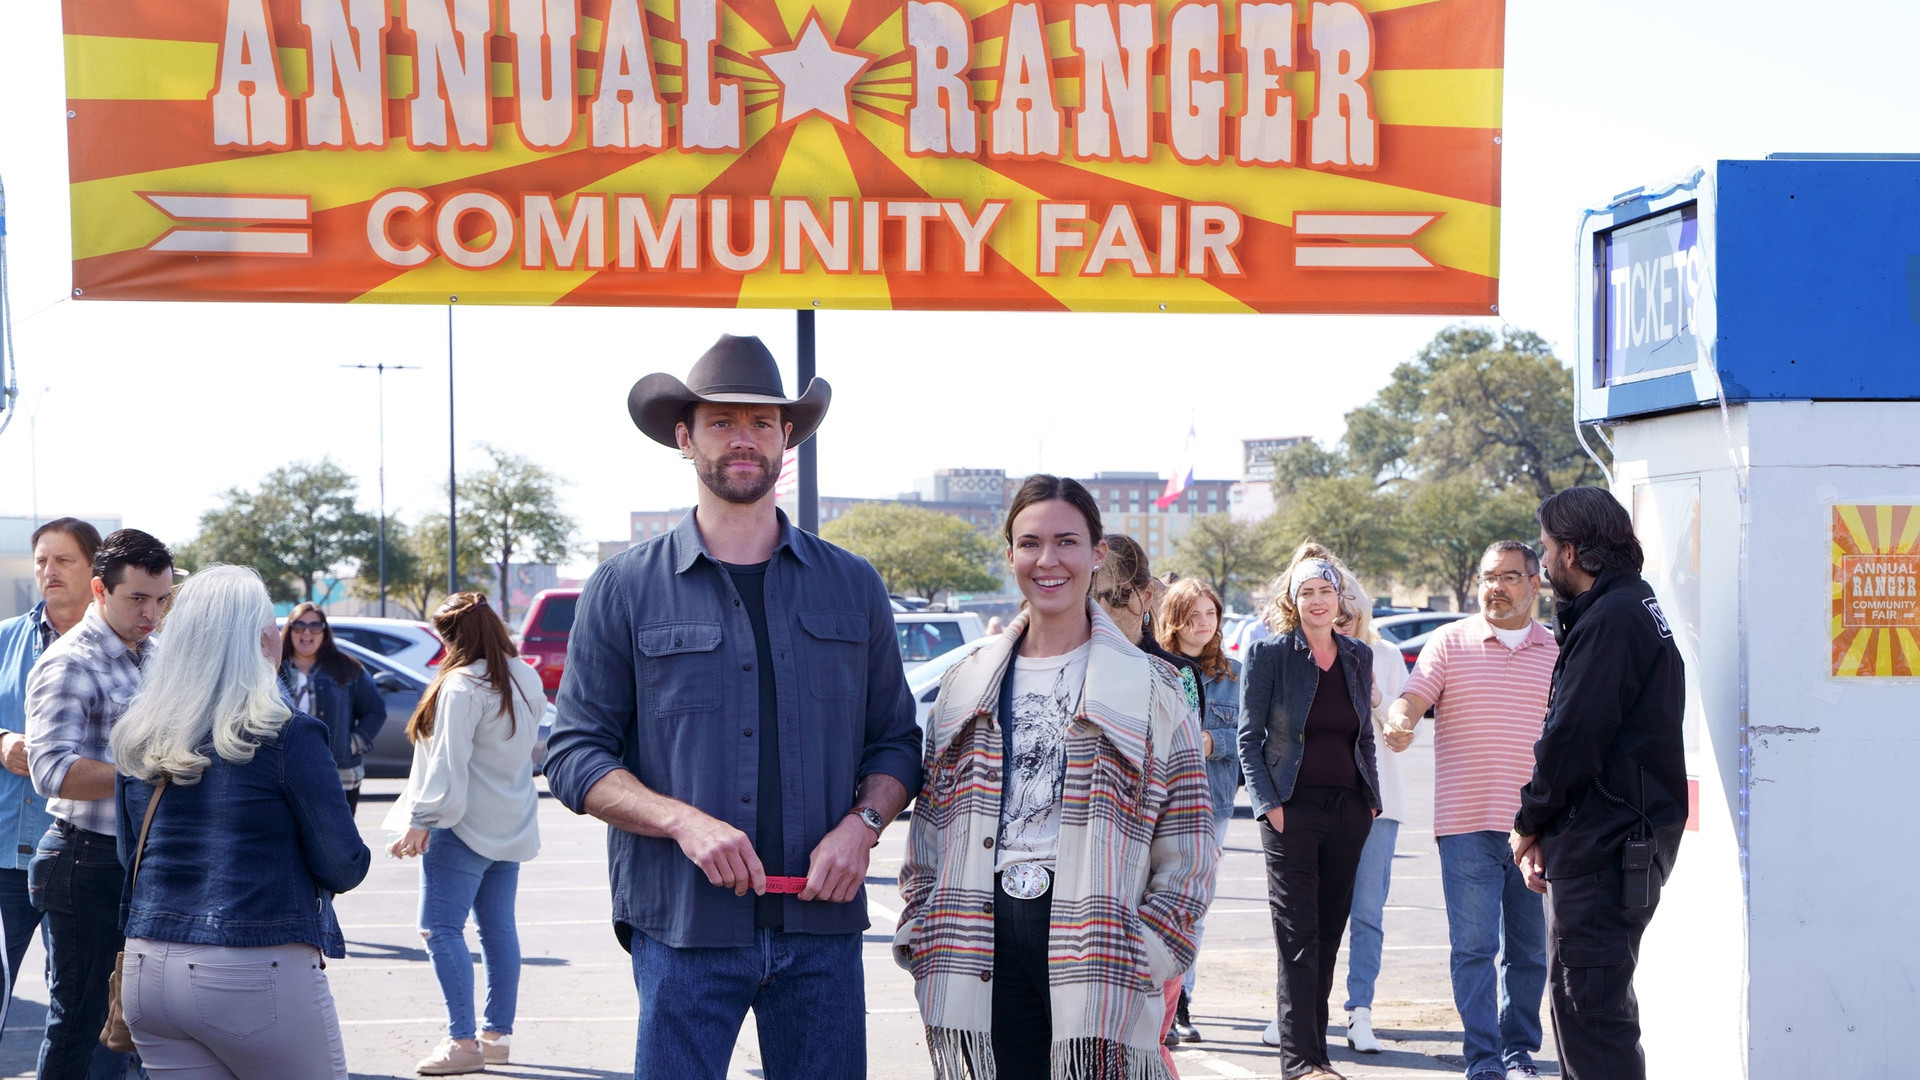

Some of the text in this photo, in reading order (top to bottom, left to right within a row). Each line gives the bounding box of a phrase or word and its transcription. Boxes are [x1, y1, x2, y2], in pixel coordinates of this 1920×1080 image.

[211, 0, 1377, 167] ANNUAL RANGER
[366, 190, 1243, 276] COMMUNITY FAIR
[1610, 245, 1700, 351] TICKETS
[1853, 562, 1917, 574] ANNUAL
[1852, 576, 1917, 597] RANGER
[1852, 600, 1916, 609] COMMUNITY
[1871, 610, 1897, 620] FAIR
